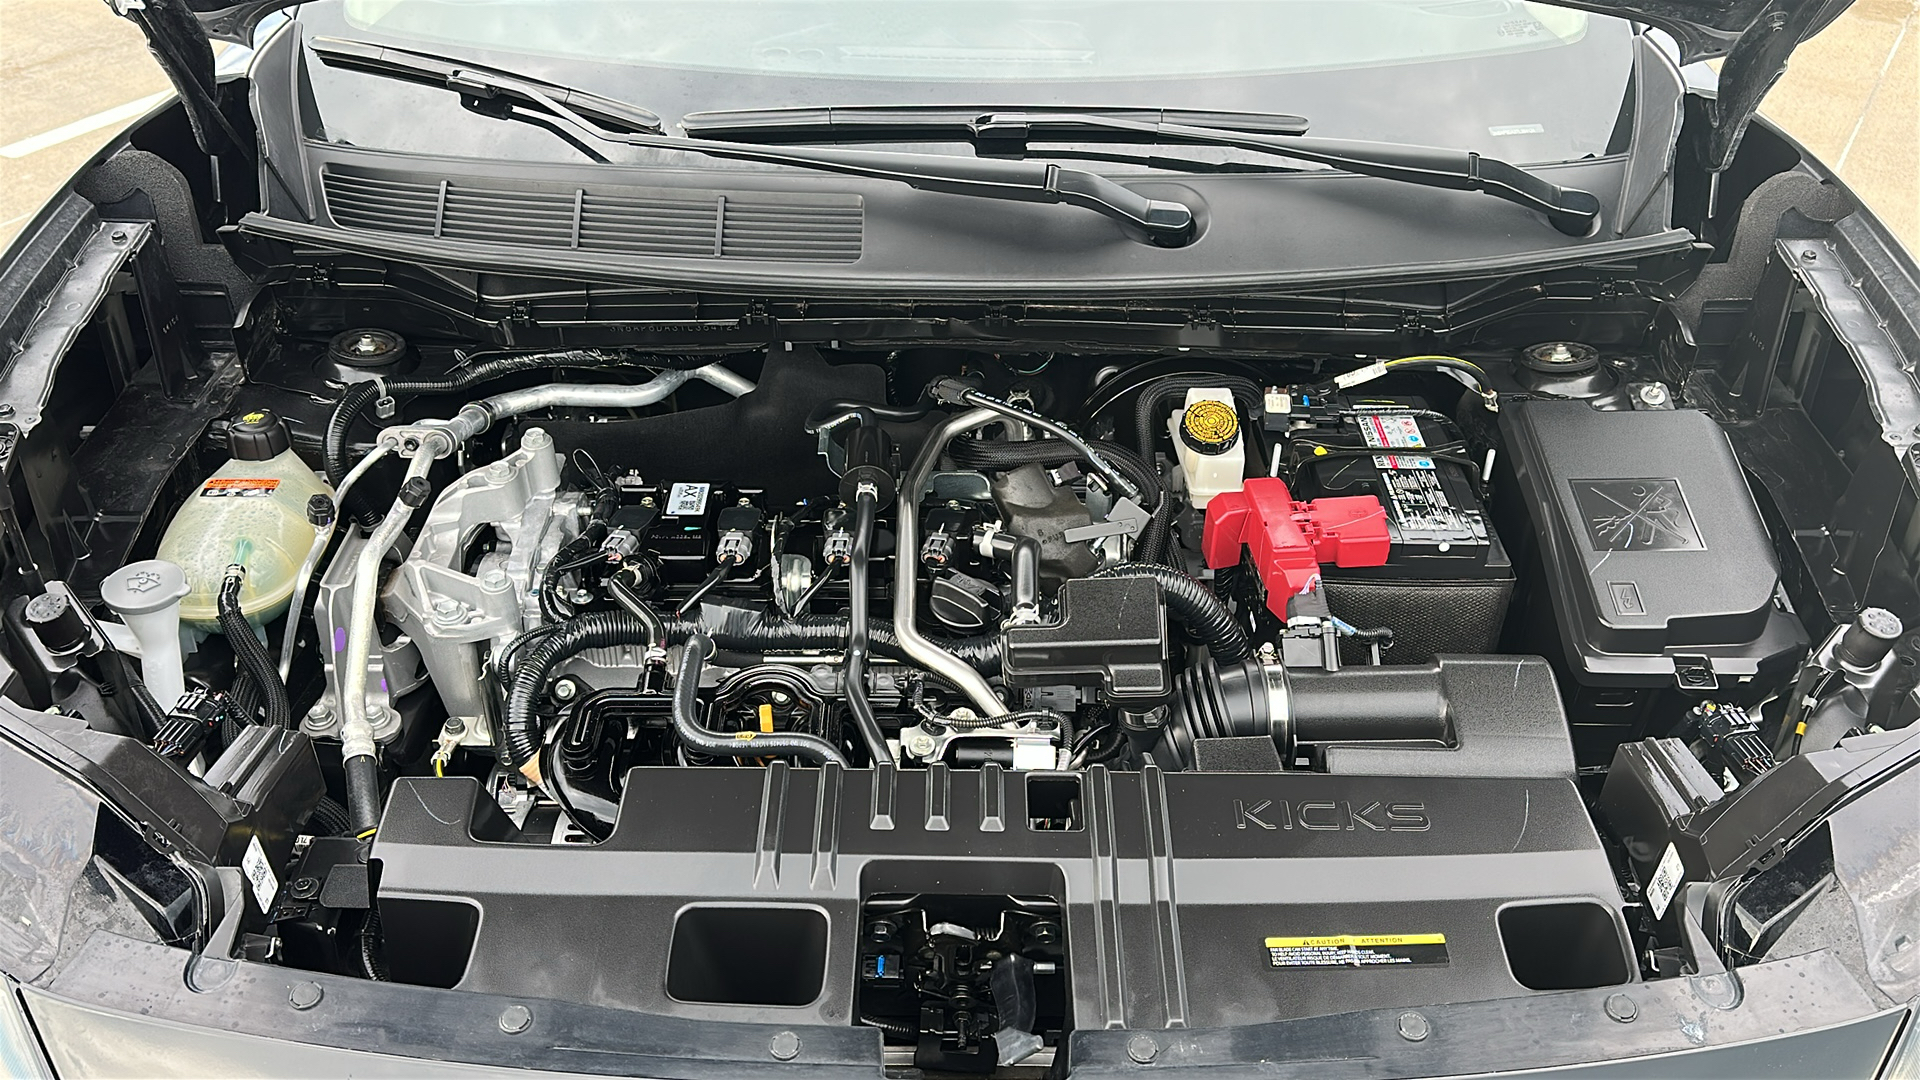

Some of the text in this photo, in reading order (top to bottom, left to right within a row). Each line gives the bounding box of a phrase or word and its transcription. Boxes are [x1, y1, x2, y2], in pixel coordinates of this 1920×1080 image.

[1360, 417, 1377, 443] NISSAN
[682, 485, 699, 498] AX
[1233, 799, 1431, 832] KICKS
